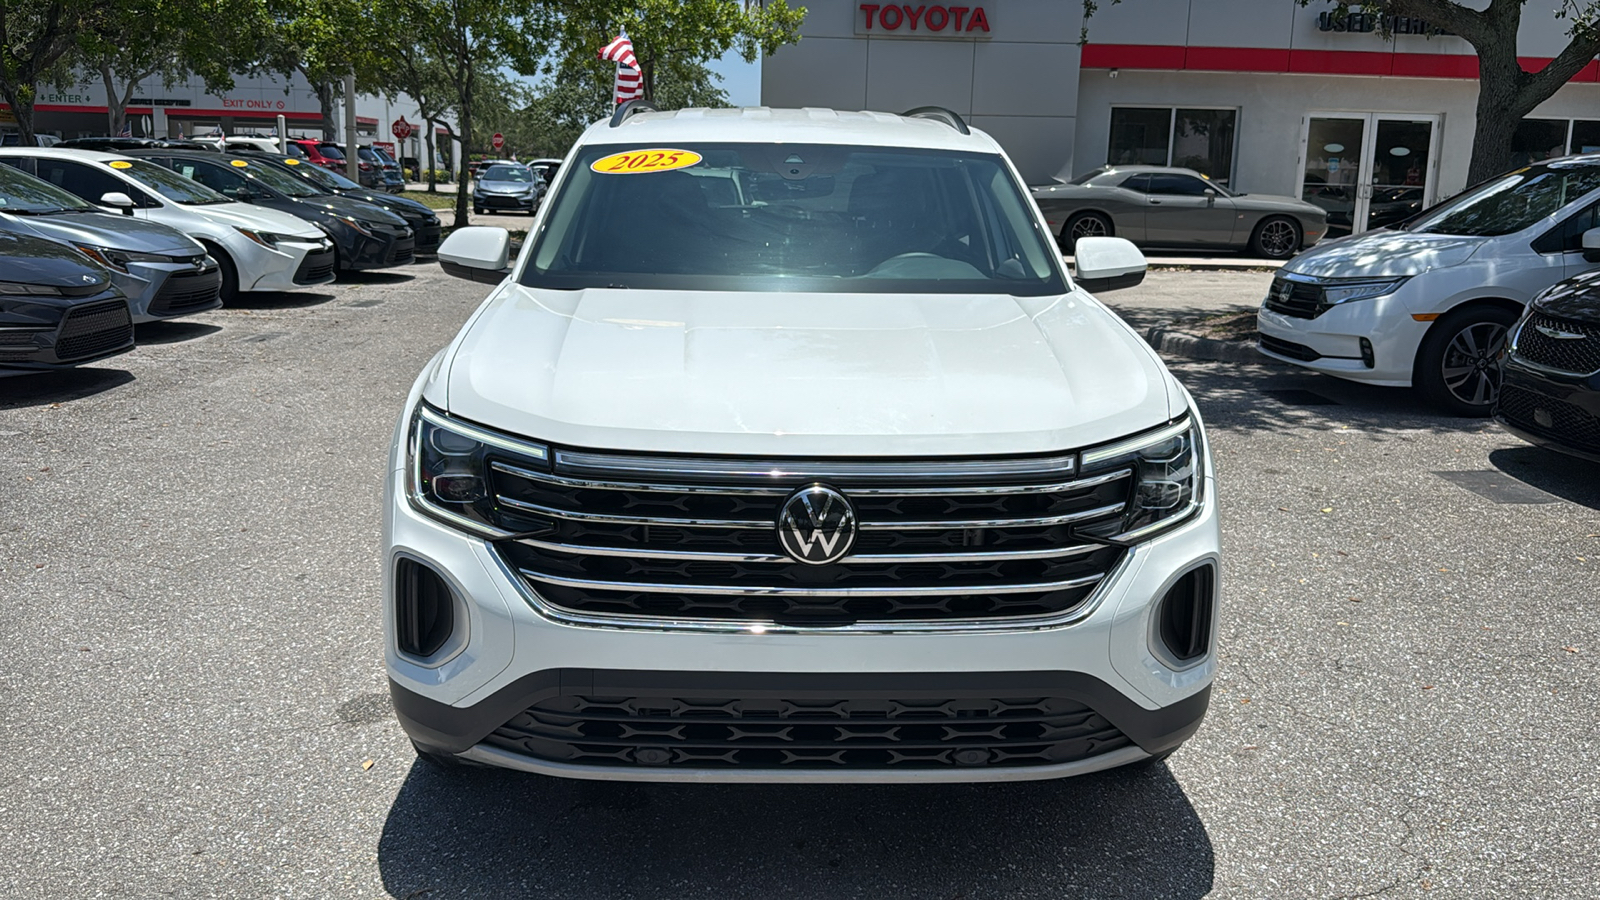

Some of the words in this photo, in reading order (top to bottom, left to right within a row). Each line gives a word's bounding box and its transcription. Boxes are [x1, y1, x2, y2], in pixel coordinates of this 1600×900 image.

[860, 4, 990, 32] TOYOTA
[1319, 11, 1376, 32] USED
[48, 94, 82, 103] ENTER
[223, 99, 244, 107] EXIT
[246, 100, 272, 108] ONLY
[608, 153, 684, 170] 2025
